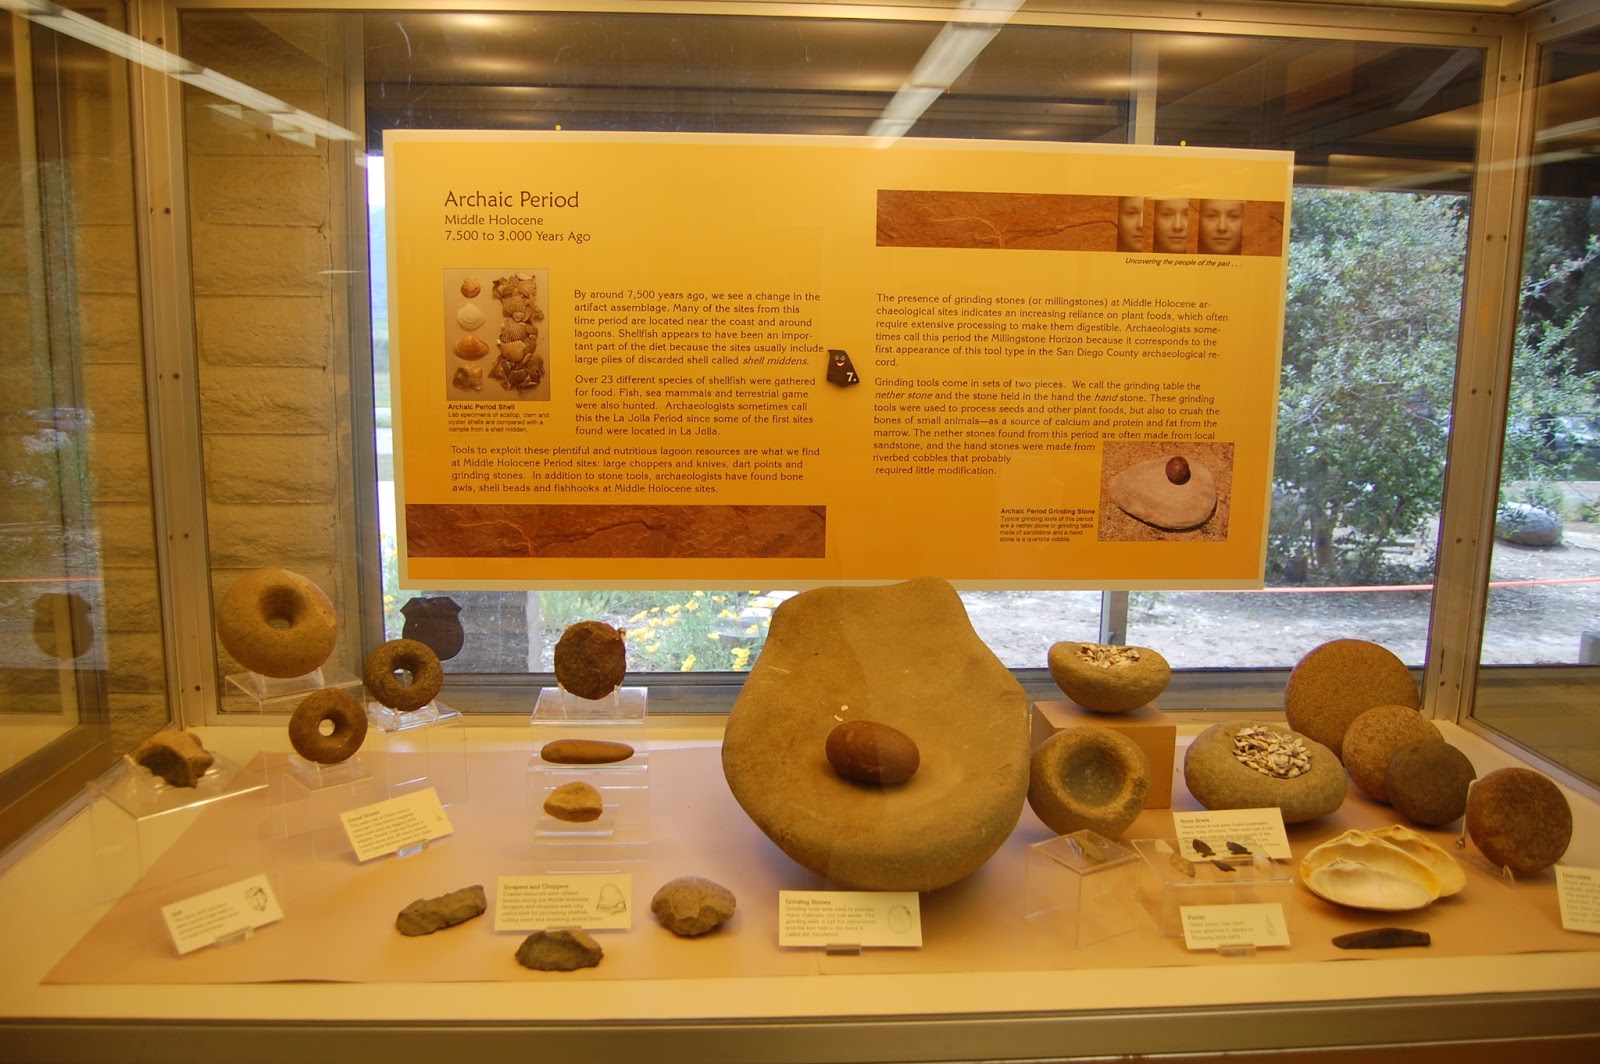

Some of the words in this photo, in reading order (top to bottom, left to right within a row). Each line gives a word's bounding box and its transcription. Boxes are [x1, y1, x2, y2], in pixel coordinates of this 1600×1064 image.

[444, 190, 512, 207] Archaic
[520, 190, 578, 208] Period
[444, 214, 484, 225] Middle
[488, 214, 543, 225] Holocene
[445, 230, 478, 241] 7,500
[482, 231, 494, 241] to
[498, 230, 532, 241] 3,000
[535, 230, 563, 241] Years
[567, 231, 590, 244] Ago
[1125, 258, 1161, 266] Uncovering
[574, 289, 586, 300] By
[590, 290, 623, 298] around
[627, 289, 655, 300] 7,500
[657, 292, 683, 301] years
[686, 292, 707, 301] ago,
[755, 291, 790, 302] change
[793, 292, 801, 300] in
[804, 292, 820, 300] the
[876, 293, 894, 302] The
[897, 295, 939, 304] presence
[941, 294, 952, 303] of
[954, 294, 992, 306] grinding
[995, 296, 1025, 304] stones
[1028, 296, 1042, 306] (or
[1044, 296, 1108, 308] millingstones)
[1122, 298, 1152, 307] Middle
[1154, 298, 1196, 308] Holocene
[574, 302, 607, 311] artifact
[610, 303, 669, 314] assemblage.
[672, 303, 699, 314] Many
[702, 303, 712, 312] of
[715, 304, 730, 312] the
[733, 304, 754, 313] sites
[757, 304, 779, 313] from
[782, 304, 799, 313] this
[875, 319, 908, 330] require
[910, 320, 954, 328] extensive
[956, 321, 1006, 331] processing
[1021, 321, 1047, 330] make
[1050, 322, 1073, 330] them
[1076, 322, 1121, 333] digestible.
[1124, 323, 1190, 334] Archaeologists
[574, 374, 598, 383] Over
[600, 374, 613, 384] 23
[616, 374, 655, 384] different
[658, 375, 693, 386] species
[695, 375, 705, 384] of
[708, 375, 746, 384] shellfish
[774, 376, 815, 387] gathered
[874, 377, 913, 388] Grinding
[916, 378, 939, 386] tools
[970, 378, 978, 387] in
[1002, 378, 1012, 388] of
[1034, 380, 1065, 390] pieces.
[1071, 380, 1085, 388] We
[1088, 380, 1103, 388] call
[1106, 380, 1121, 389] the
[1123, 381, 1159, 392] grinding
[1162, 381, 1184, 390] table
[1186, 382, 1200, 390] the
[575, 425, 602, 434] found
[631, 426, 665, 435] located
[668, 426, 676, 435] in
[680, 426, 691, 435] La
[694, 426, 720, 435] Jolla.
[452, 483, 475, 492] awls,
[478, 483, 499, 491] shell
[502, 483, 530, 492] beads
[533, 483, 551, 492] and
[554, 483, 599, 492] fishhooks
[614, 483, 645, 492] Middle
[648, 483, 691, 492] Holocene
[694, 484, 718, 492] sites.
